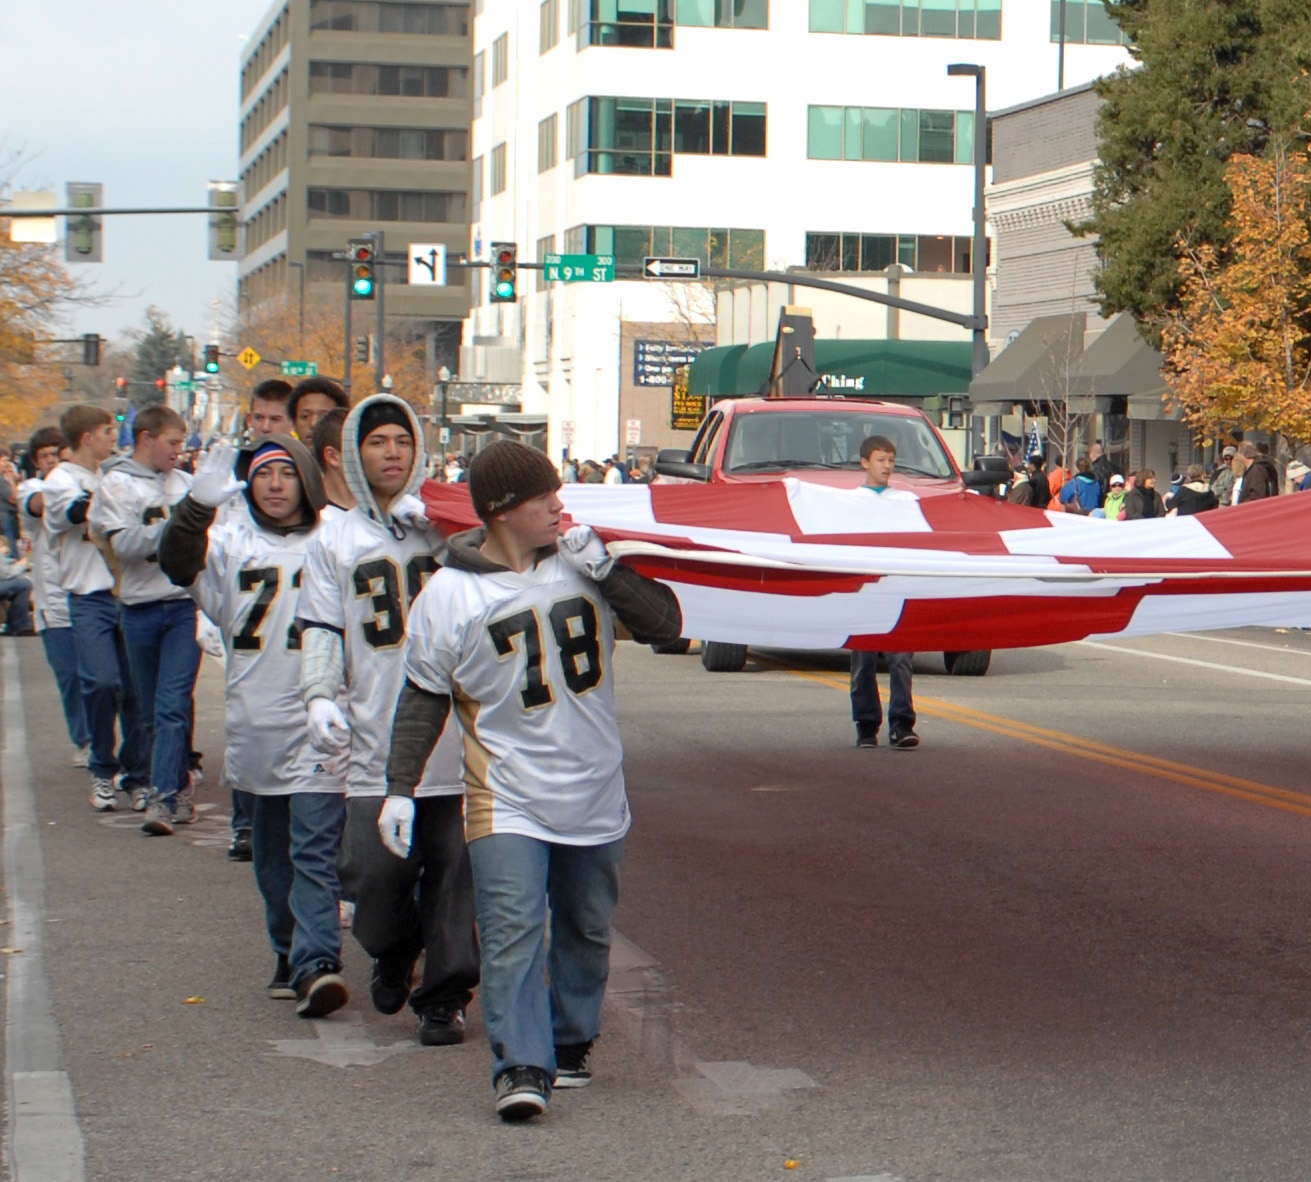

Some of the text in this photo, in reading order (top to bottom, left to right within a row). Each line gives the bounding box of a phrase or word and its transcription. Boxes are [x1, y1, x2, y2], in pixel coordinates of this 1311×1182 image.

[593, 267, 607, 281] ST
[232, 565, 303, 651] 7
[485, 593, 605, 711] 78
